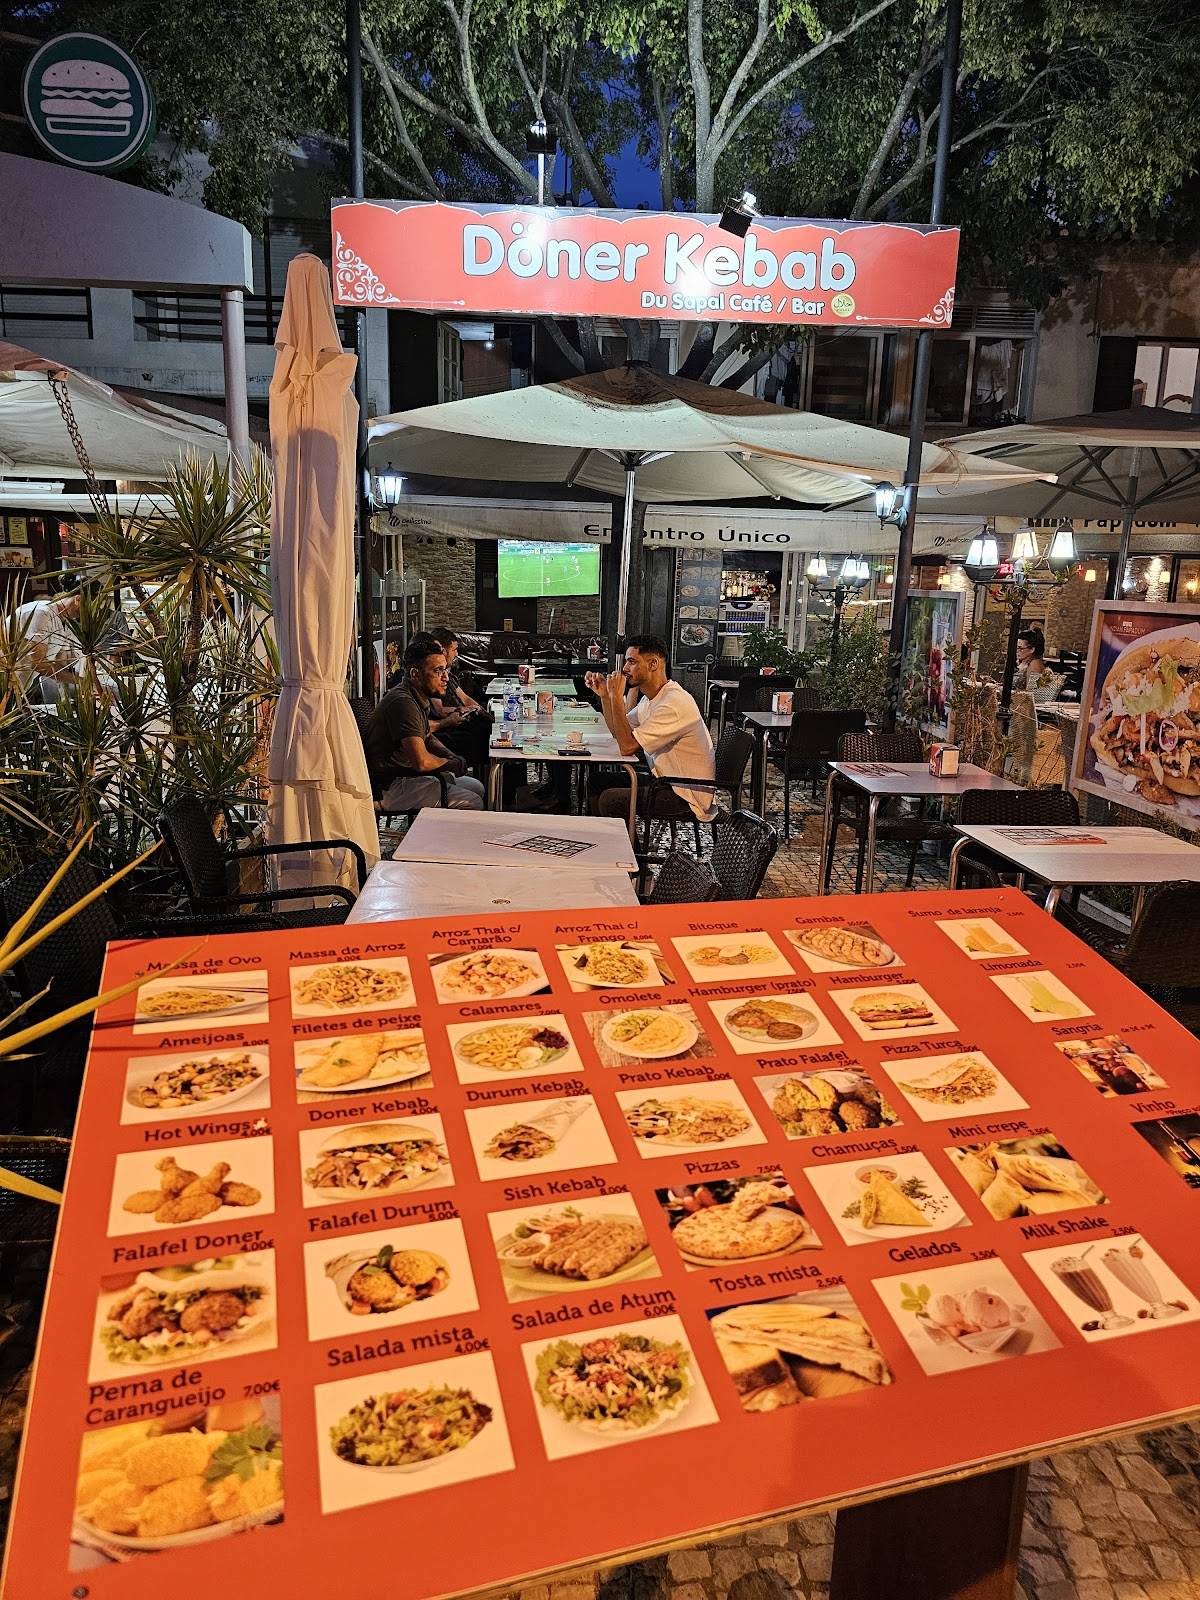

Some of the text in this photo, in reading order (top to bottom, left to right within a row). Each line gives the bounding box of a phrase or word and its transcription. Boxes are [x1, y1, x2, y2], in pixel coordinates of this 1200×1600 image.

[461, 222, 858, 292] Döner Kebab
[640, 290, 825, 316] Du Sapal Café / Bar
[583, 524, 791, 544] Enntro Único
[961, 906, 1002, 914] laranja
[688, 922, 737, 930] Bitoque
[795, 915, 844, 924] Gambas
[432, 929, 470, 938] Arroz
[472, 926, 505, 934] Thai
[554, 925, 591, 933] Arroz
[447, 934, 511, 946] Camarão
[577, 934, 625, 945] Frango
[289, 943, 405, 960] Massa de Arroz
[203, 958, 223, 967] de
[228, 956, 261, 965] Ovo
[980, 959, 1042, 970] Limonada
[688, 978, 816, 996] Hamburger (prato)
[829, 973, 902, 984] Hamburger
[599, 992, 661, 1003] Omolete
[459, 1003, 540, 1016] Calamares
[292, 1014, 420, 1033] Filetes de peixe
[1051, 1023, 1102, 1035] Sangria
[158, 1033, 244, 1048] Ameijoas
[881, 1040, 964, 1054] Pizza Turca
[756, 1050, 848, 1068] Prato Falafel
[618, 1065, 714, 1083] Prato Kebab
[466, 1079, 583, 1101] Durum Kebab
[308, 1097, 428, 1121] Doner Kebab
[1130, 1100, 1175, 1112] Vinho
[144, 1121, 252, 1141] Hot Wings
[948, 1121, 1031, 1138] Mini crepe
[811, 1139, 897, 1157] Chamuças
[684, 1160, 739, 1174] Pizzas
[503, 1176, 605, 1200] Sish Kebab
[309, 1200, 456, 1231] Falafel Durum
[1020, 1216, 1108, 1239] Milk Shake
[113, 1230, 262, 1262] Falafel Doner
[888, 1242, 960, 1262] Gelados
[709, 1265, 821, 1292] Tosta mista
[511, 1290, 675, 1329] Salada de Atum
[328, 1327, 474, 1366] Salada mista
[89, 1369, 201, 1403] Perna de
[86, 1388, 224, 1424] Carangueijo
